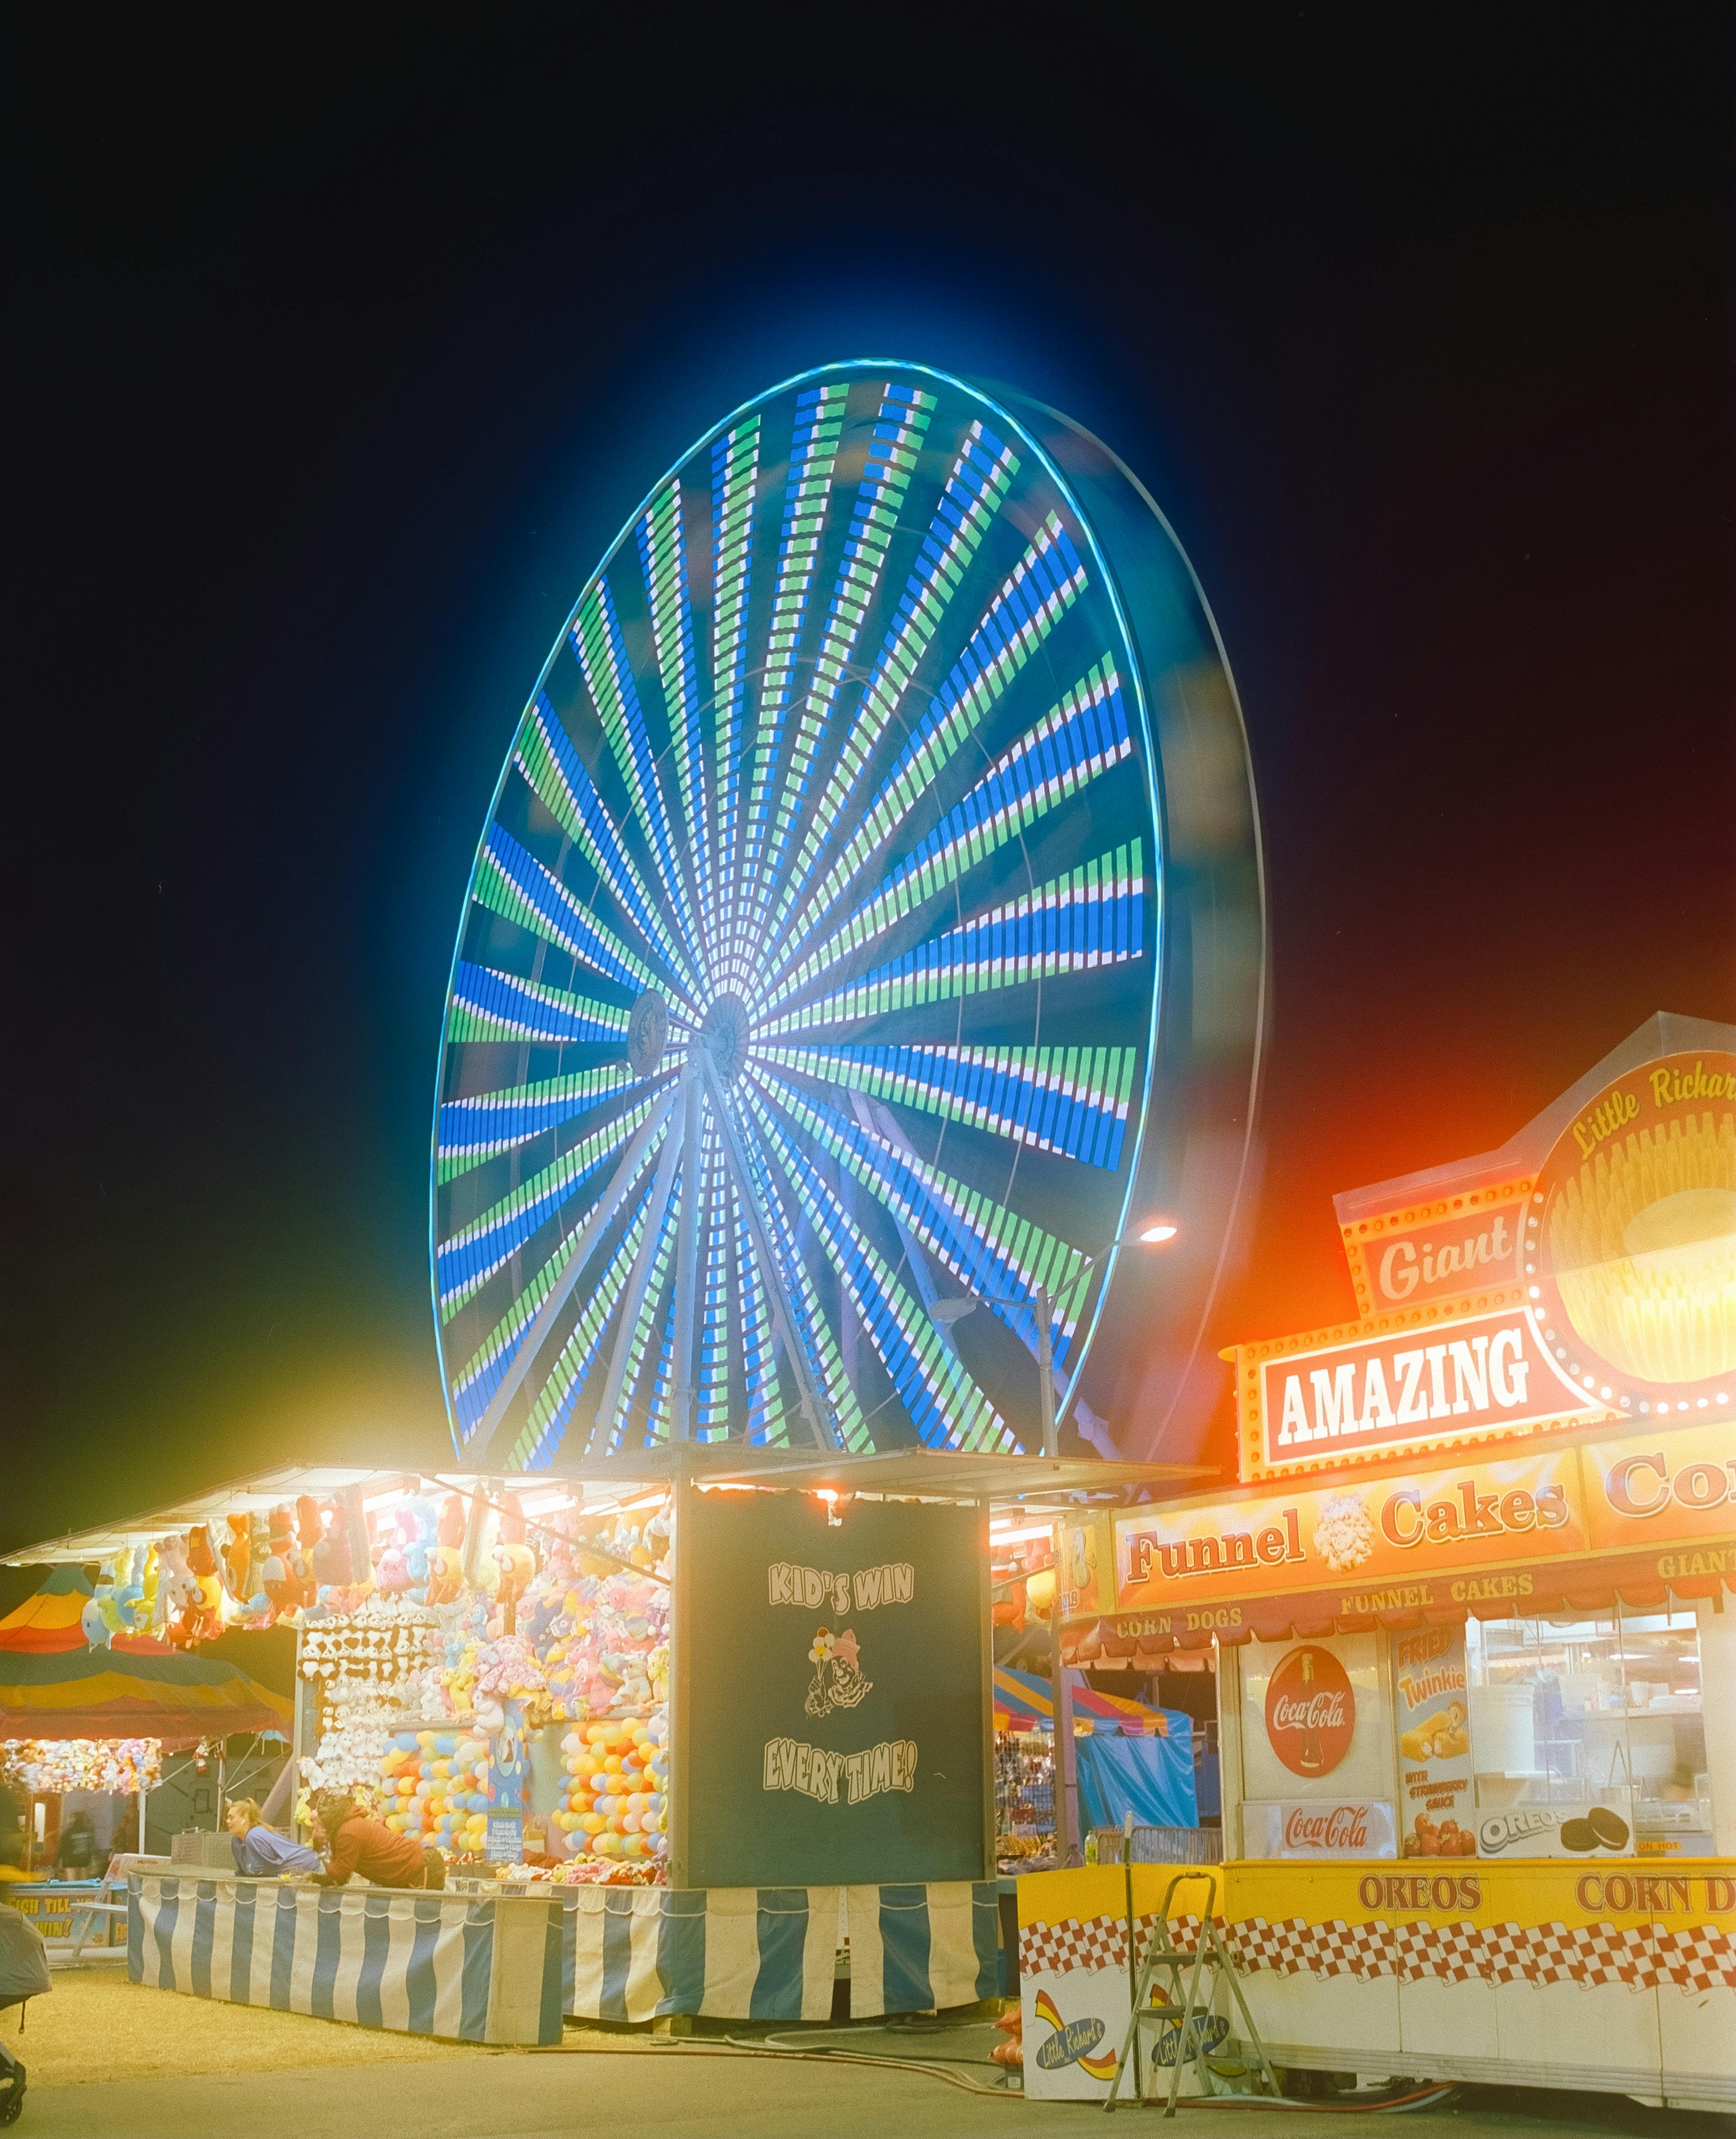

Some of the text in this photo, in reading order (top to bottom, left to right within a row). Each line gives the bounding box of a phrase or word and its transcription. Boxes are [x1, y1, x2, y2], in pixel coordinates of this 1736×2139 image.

[1573, 1090, 1640, 1160] Little
[1379, 1216, 1514, 1300] Giant
[1277, 1328, 1529, 1445] AMAZING
[1604, 1451, 1736, 1519] Co
[1126, 1480, 1569, 1584] Funnel Cakes
[768, 1562, 914, 1616] KID'S WIN
[1341, 1573, 1533, 1616] FUNNEL CAKES
[1116, 1607, 1242, 1639] CORN DOGS
[1399, 1667, 1465, 1710] Twinkie
[763, 1737, 918, 1805] EVERY TIME!
[1405, 1770, 1428, 1785] WITH
[44, 1898, 71, 1914] TILL
[1358, 1873, 1483, 1912] OREOS
[1575, 1872, 1693, 1914] CORN
[1042, 2033, 1065, 2068] Little
